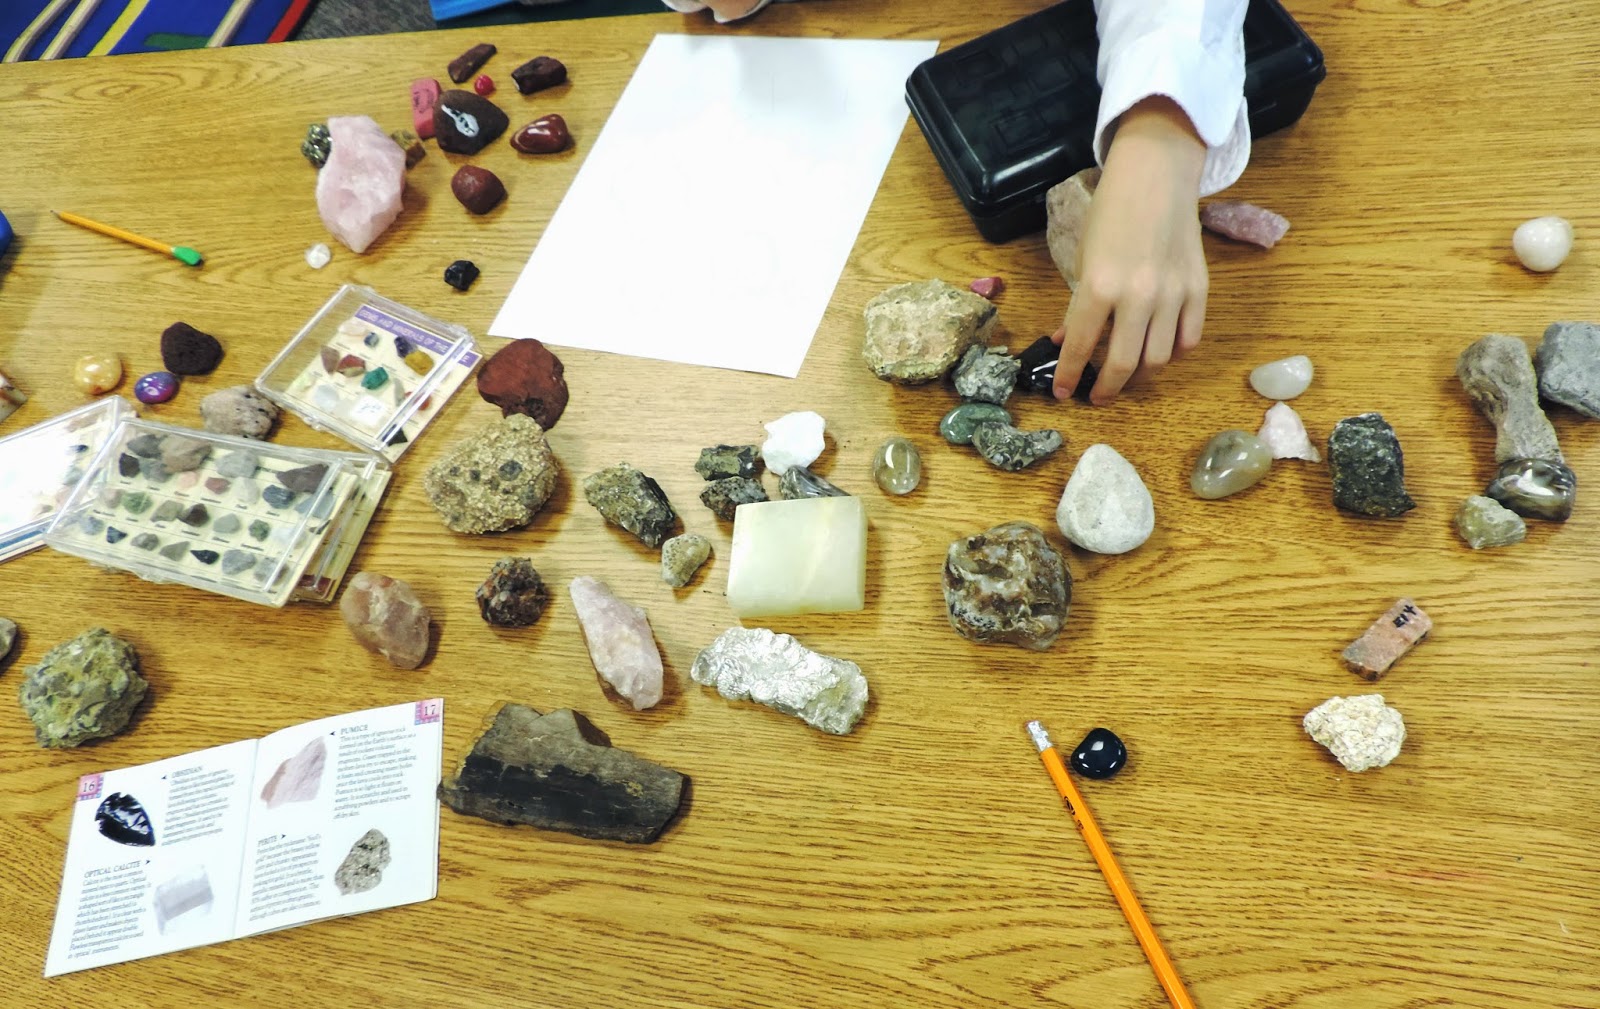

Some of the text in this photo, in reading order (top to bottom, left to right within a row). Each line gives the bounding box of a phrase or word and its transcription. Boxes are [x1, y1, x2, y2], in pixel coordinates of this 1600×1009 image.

[378, 318, 394, 329] AND
[391, 323, 425, 342] MINERALS
[423, 336, 435, 346] OF
[424, 704, 436, 716] 17
[340, 724, 369, 736] PUMICE
[83, 782, 96, 793] 16
[84, 860, 141, 879] OPTICAL CALCITE
